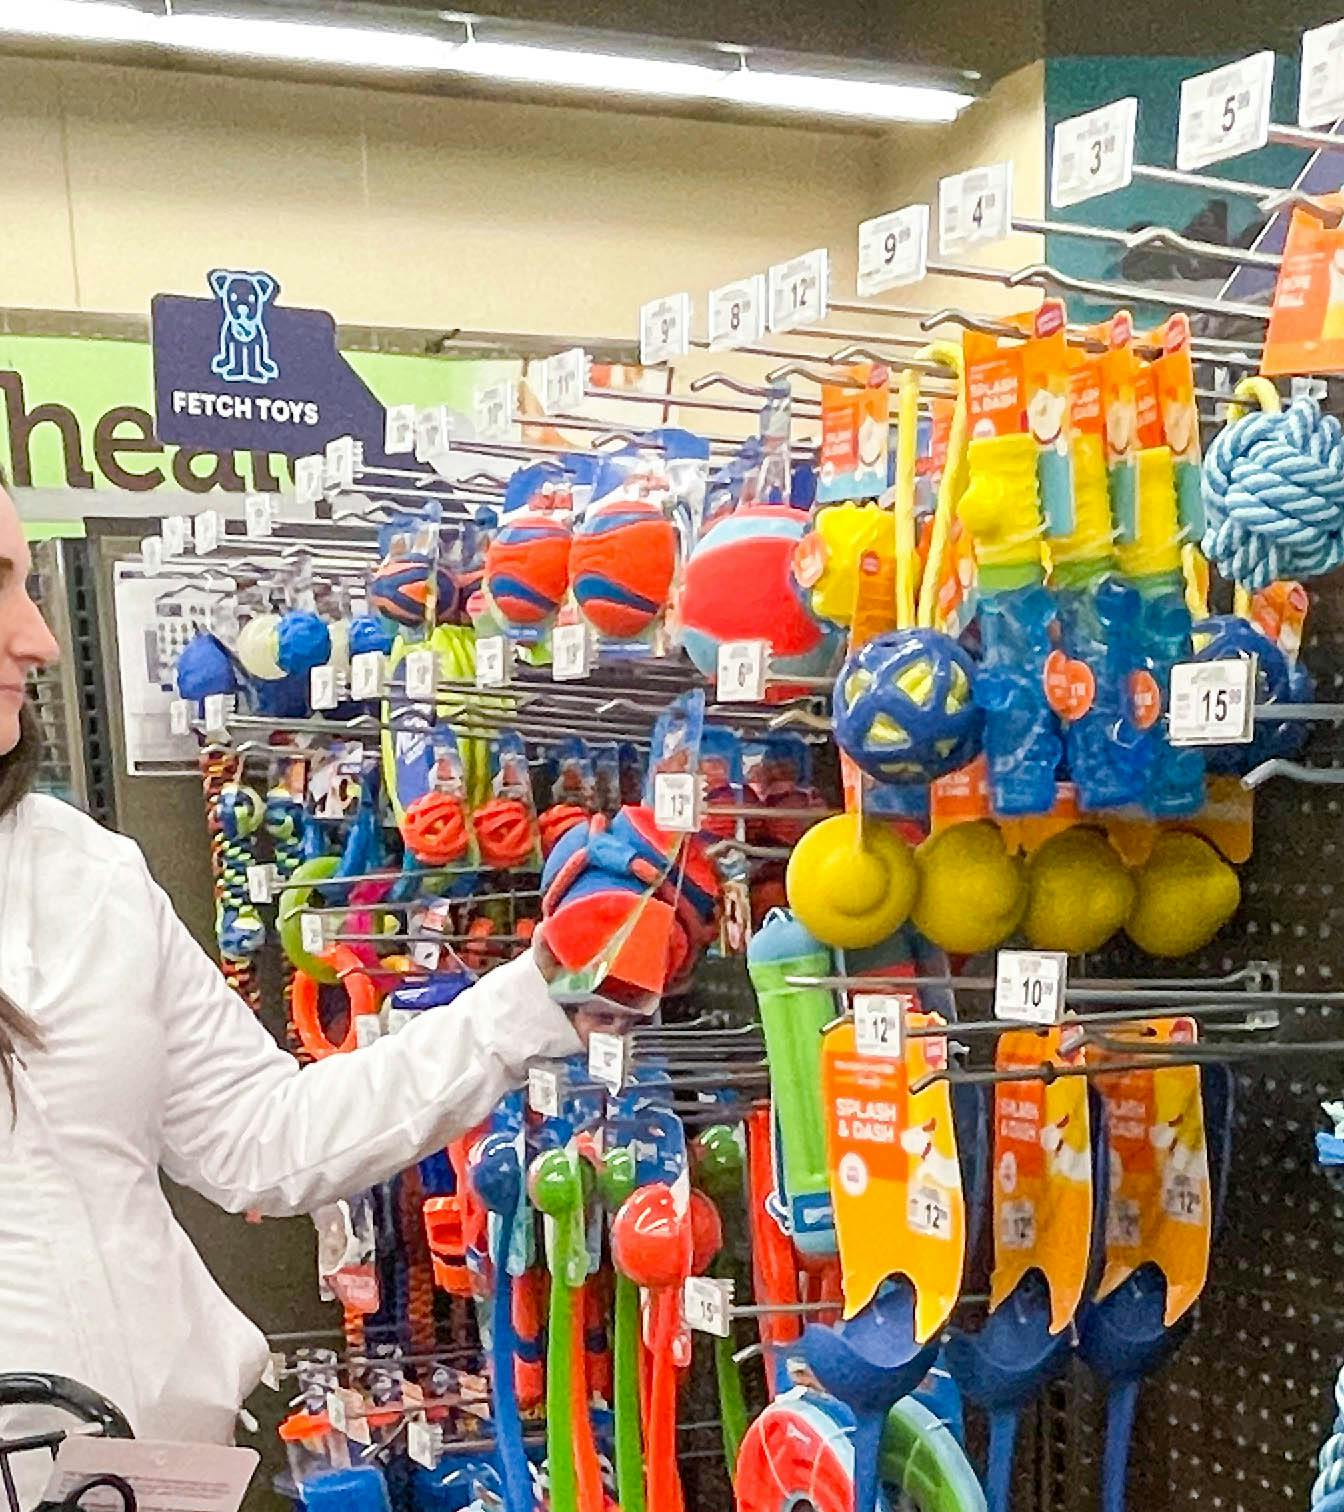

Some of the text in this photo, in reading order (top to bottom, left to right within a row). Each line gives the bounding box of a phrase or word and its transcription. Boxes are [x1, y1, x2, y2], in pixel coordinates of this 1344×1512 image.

[172, 390, 320, 426] FETCH TOYS
[835, 1098, 897, 1122] SPLASH
[837, 1119, 895, 1143] & DASH
